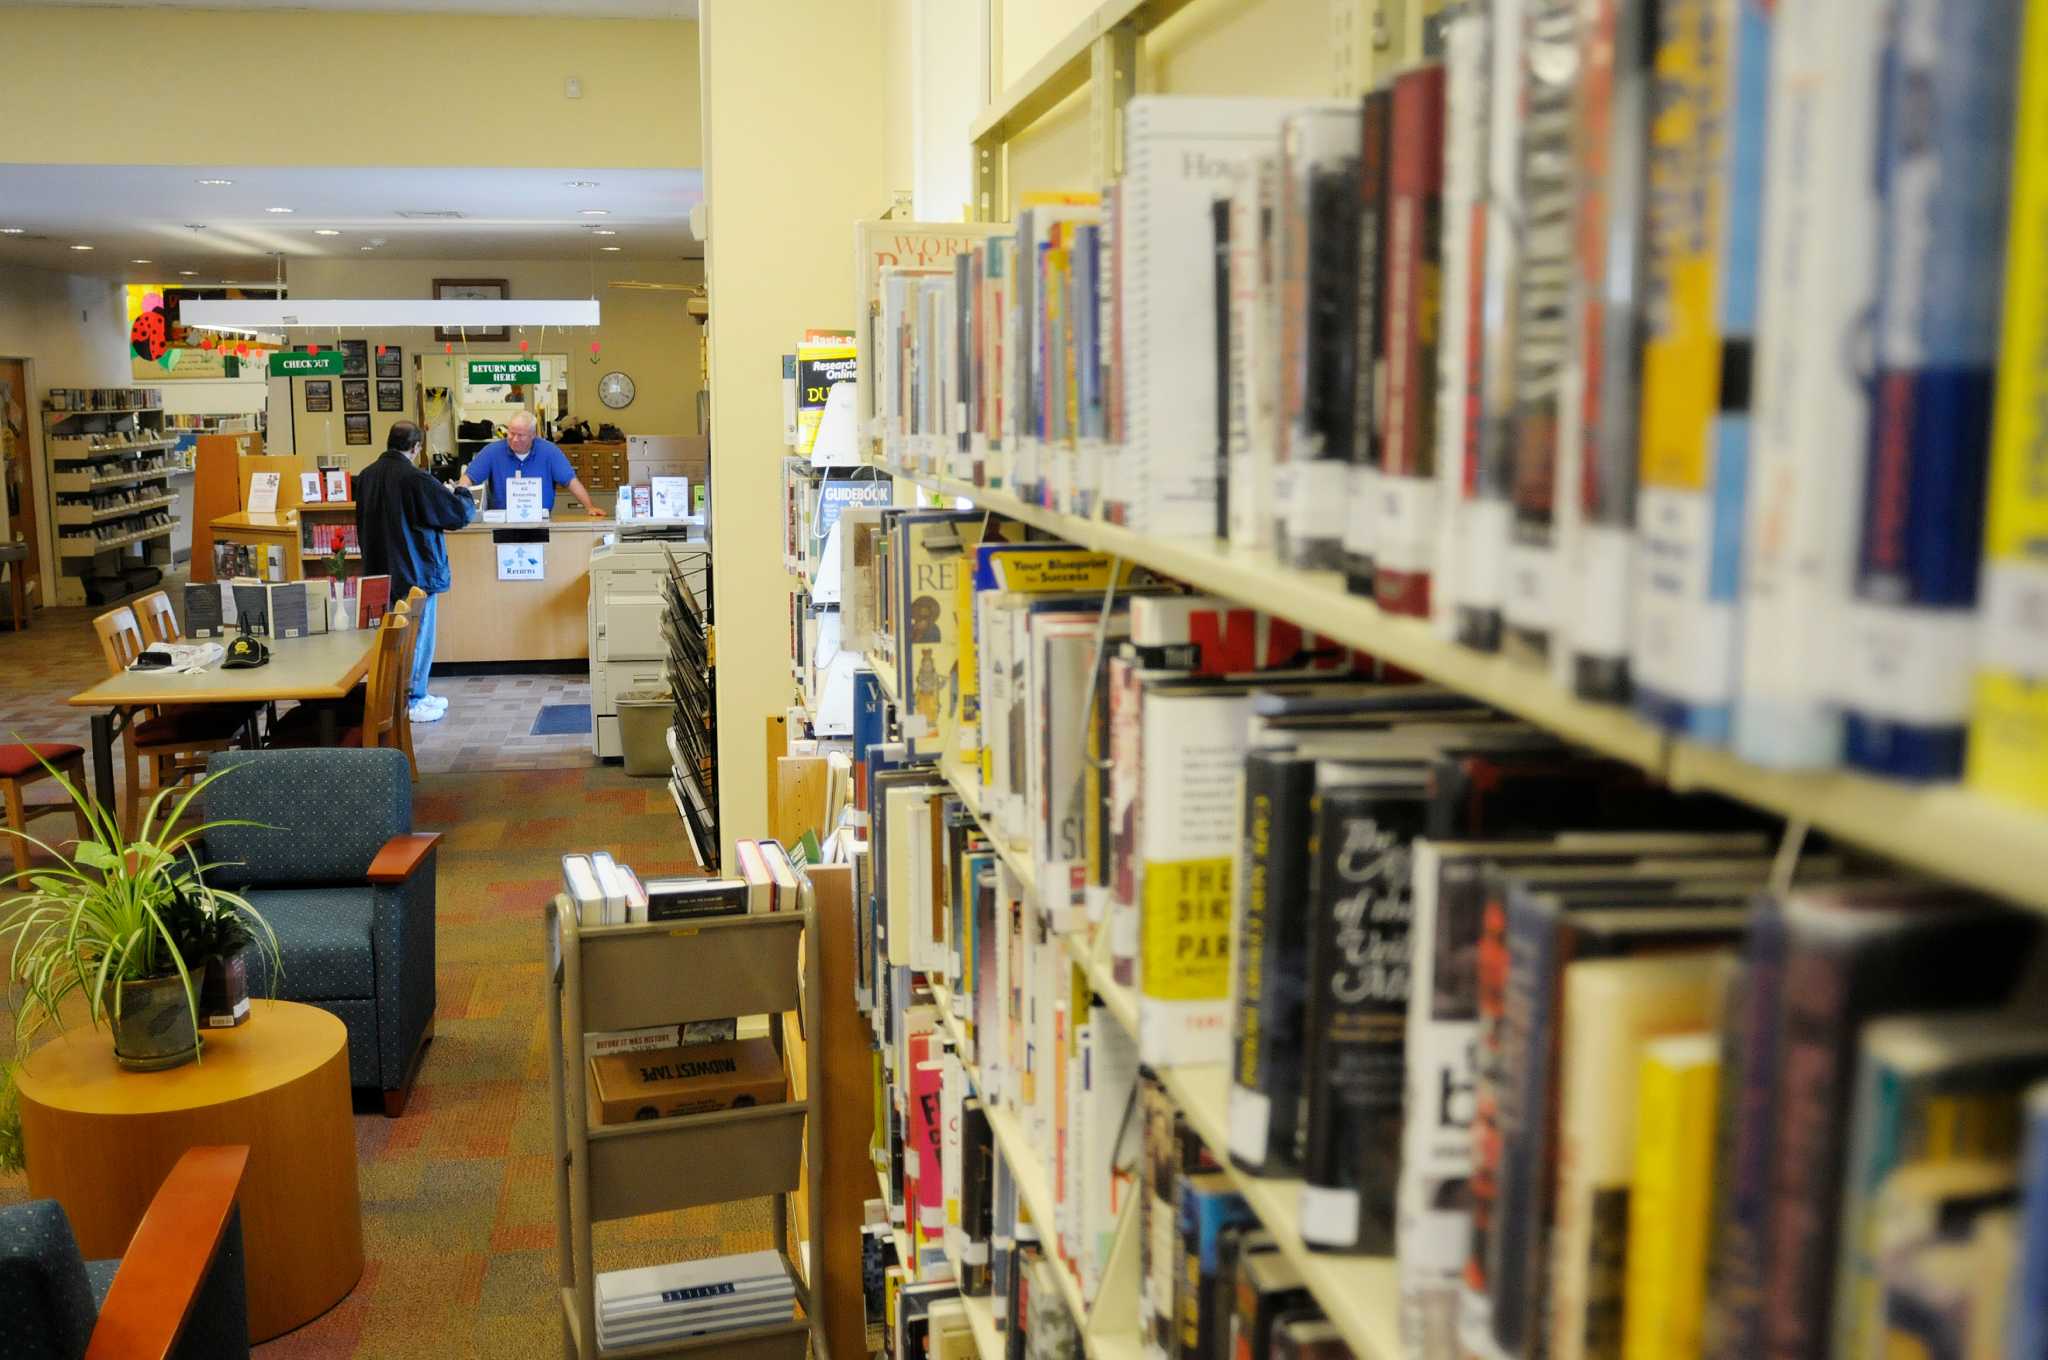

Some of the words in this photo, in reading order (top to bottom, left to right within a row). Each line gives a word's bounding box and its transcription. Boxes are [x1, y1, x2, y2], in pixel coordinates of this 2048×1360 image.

[472, 364, 507, 373] RETURN
[509, 364, 537, 373] BOOKS
[493, 373, 517, 382] HERE
[825, 487, 888, 501] GUIDEBOOK
[506, 567, 536, 575] Returns
[1013, 560, 1043, 571] Your
[1047, 558, 1108, 573] Blueprint
[1041, 571, 1089, 583] Success
[639, 1064, 674, 1083] TAPE
[677, 1057, 737, 1078] MIDWEST
